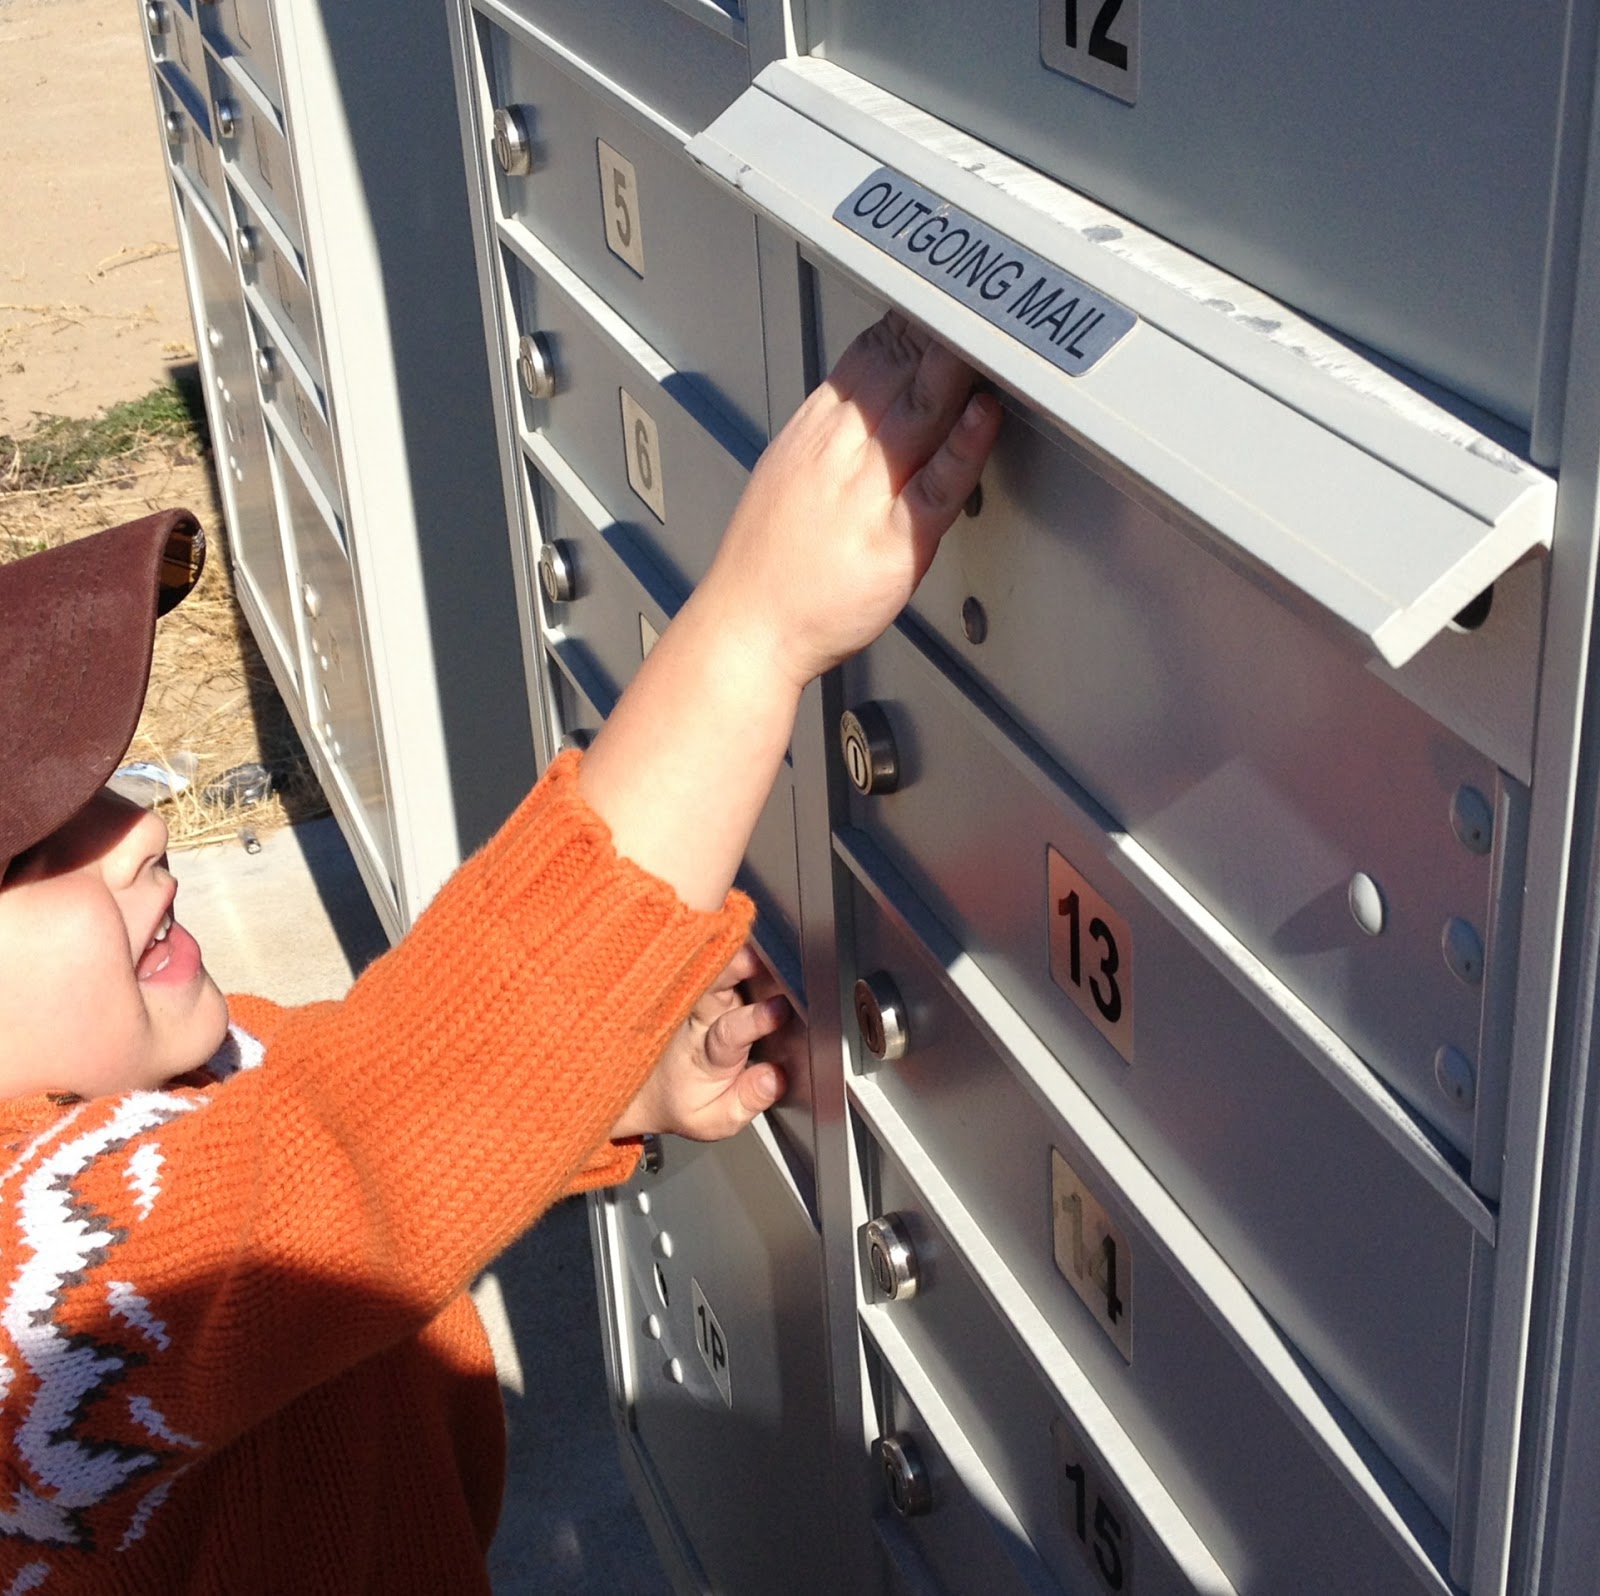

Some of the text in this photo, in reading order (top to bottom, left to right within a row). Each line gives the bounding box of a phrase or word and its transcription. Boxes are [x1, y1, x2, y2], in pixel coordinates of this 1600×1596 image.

[1064, 0, 1128, 71] 12
[614, 168, 632, 247] 5
[852, 182, 1105, 360] OUTGOING MAIL
[635, 418, 653, 490] 6
[1058, 889, 1122, 1023] 13
[1062, 1191, 1123, 1326] 14
[698, 1304, 725, 1372] 1P
[1065, 1463, 1123, 1592] 15
